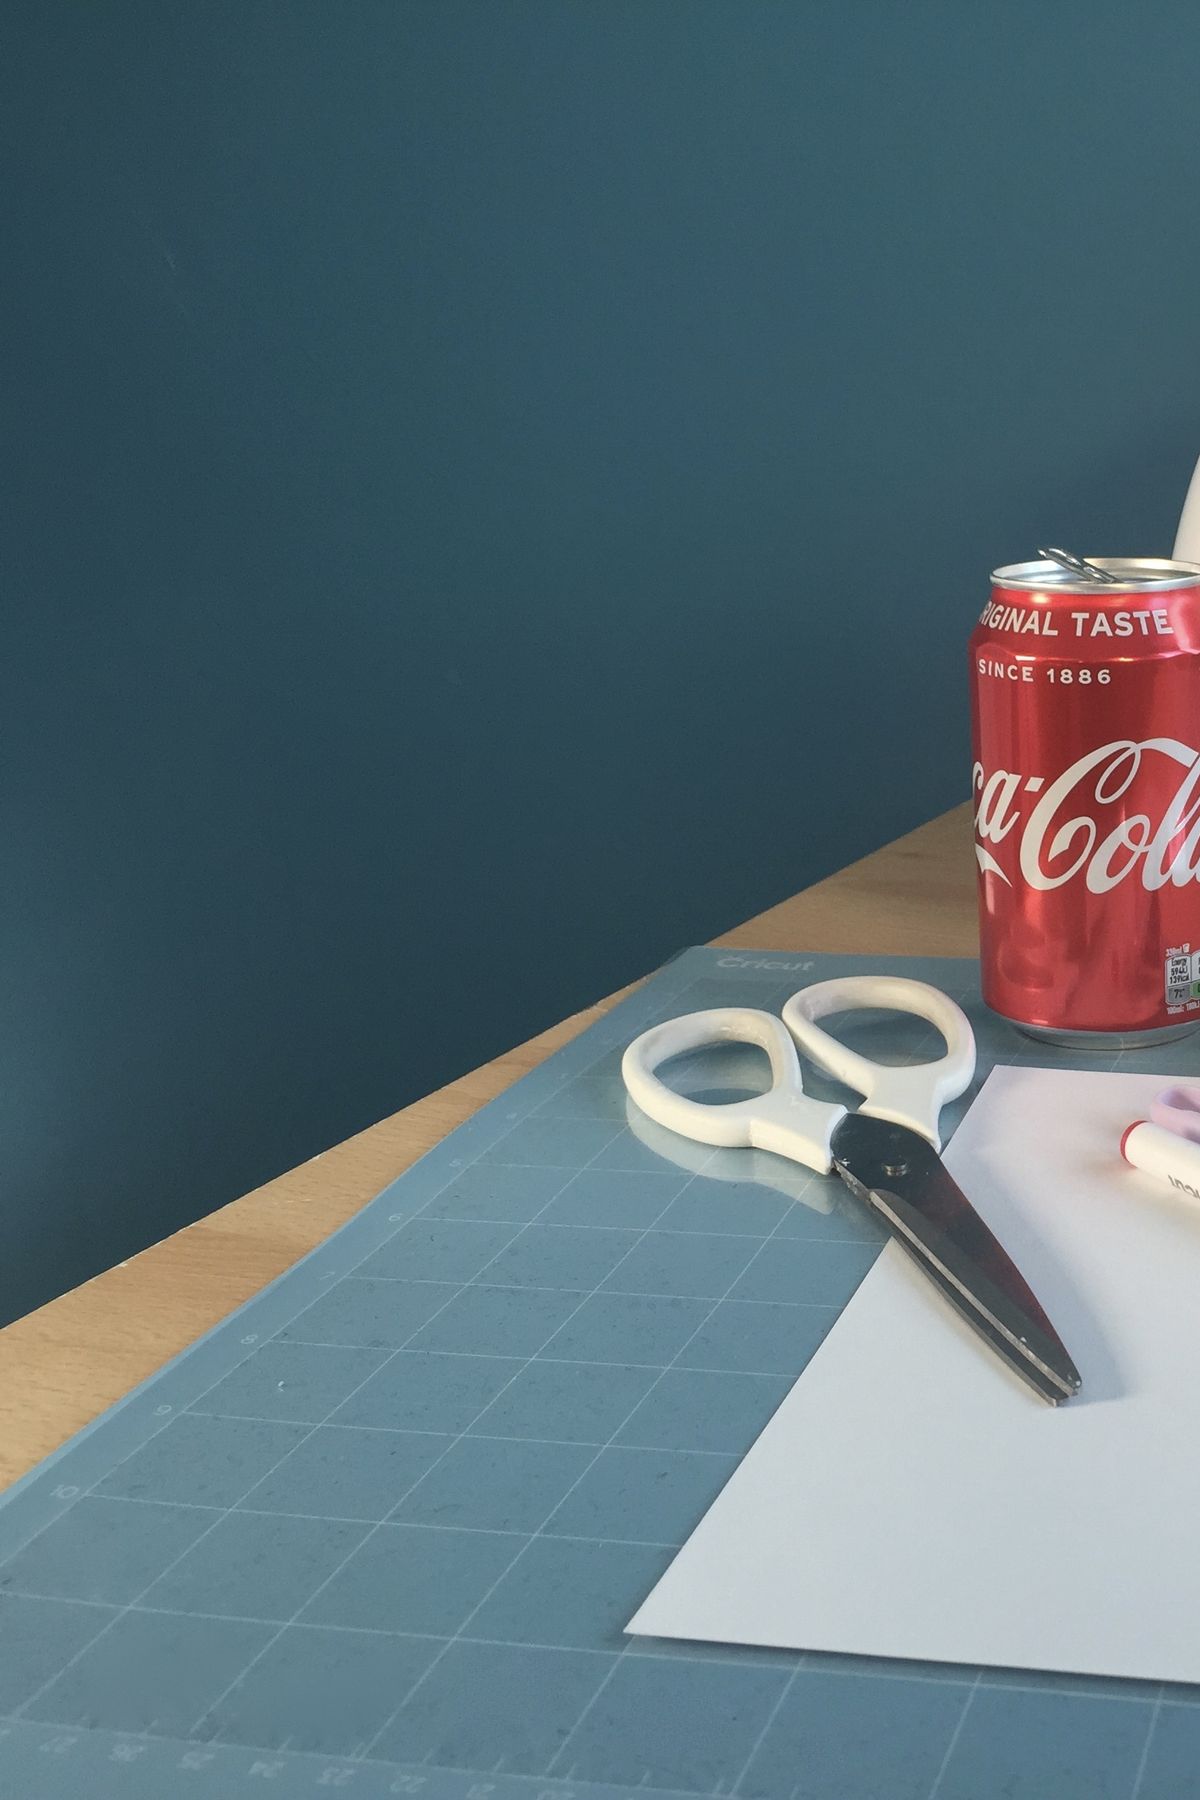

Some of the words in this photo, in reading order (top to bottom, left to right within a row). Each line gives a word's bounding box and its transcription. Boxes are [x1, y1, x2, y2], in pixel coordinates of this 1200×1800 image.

[979, 600, 1059, 636] RIGINAL
[1071, 608, 1175, 637] TASTE
[978, 658, 1034, 682] SINCE
[1046, 668, 1112, 685] 1886
[716, 955, 815, 971] Cricut
